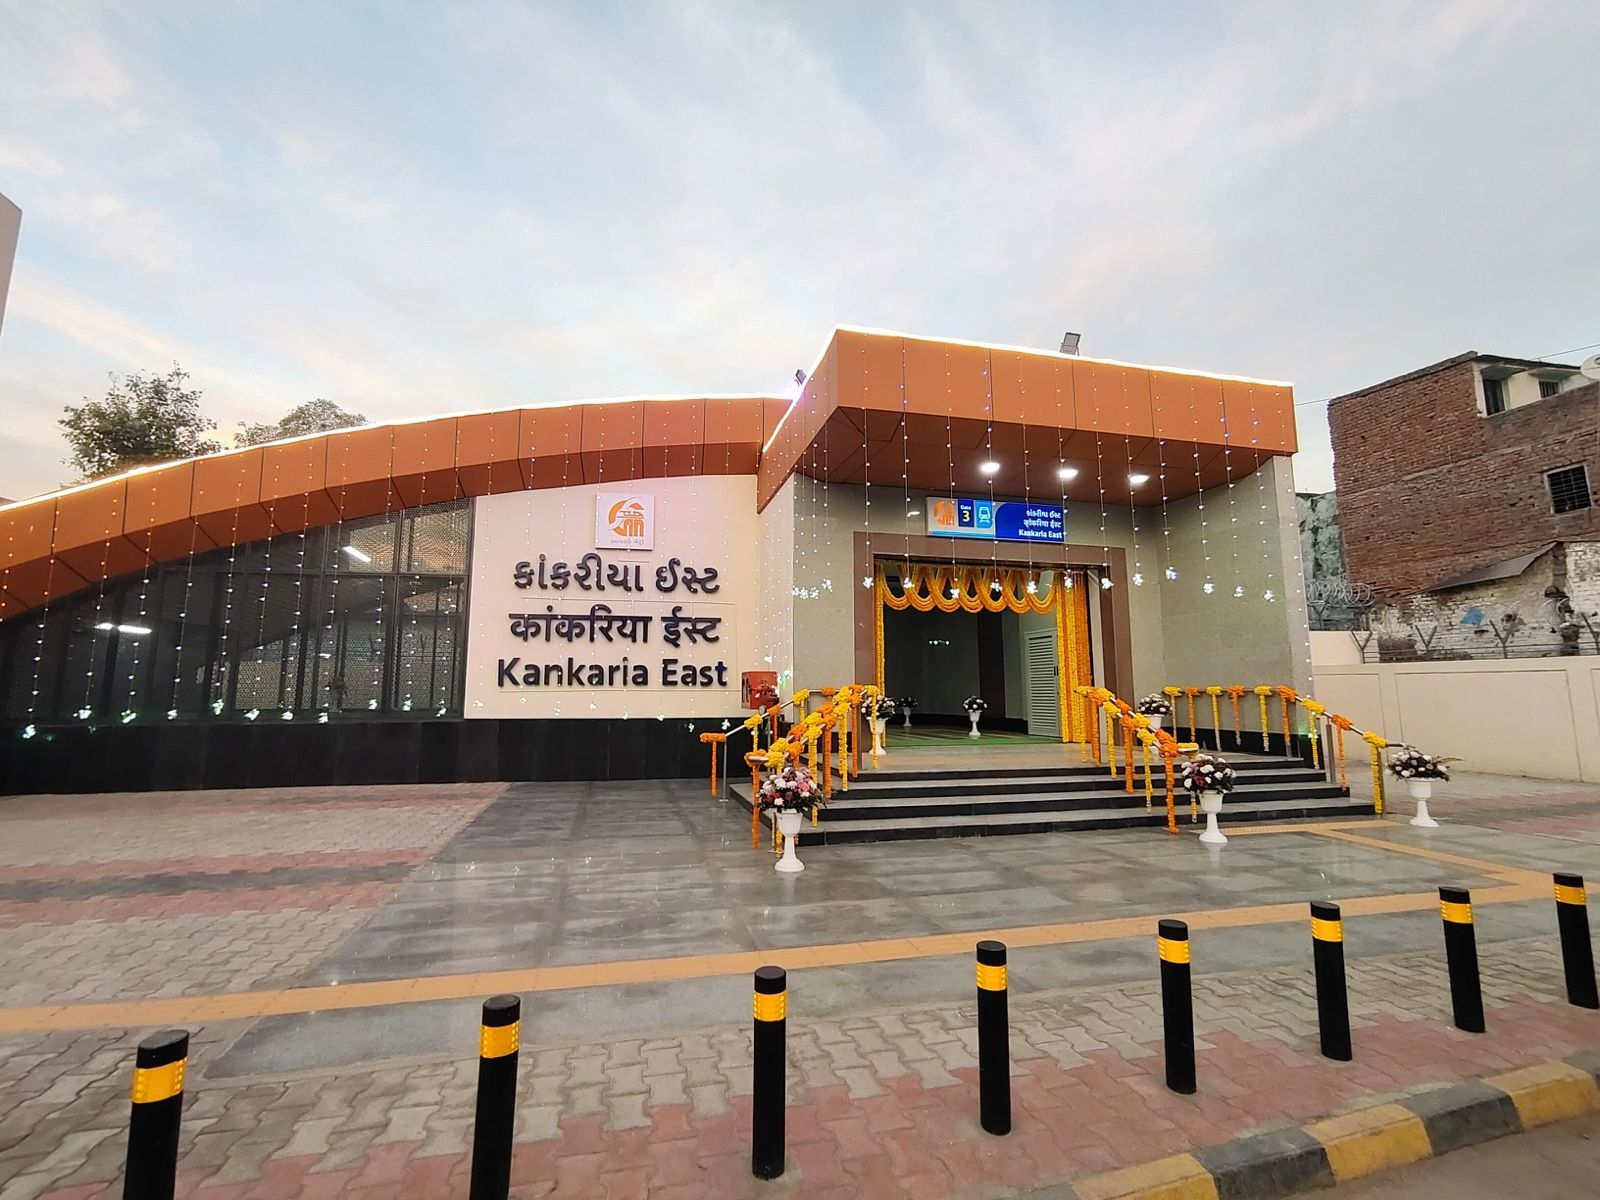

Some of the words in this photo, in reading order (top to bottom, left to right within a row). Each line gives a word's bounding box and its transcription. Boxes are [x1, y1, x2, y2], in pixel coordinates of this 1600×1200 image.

[962, 510, 970, 522] 3
[1018, 528, 1047, 538] Kankaria
[1048, 530, 1062, 539] East
[513, 552, 644, 592] કાંકરીયા
[655, 557, 720, 593] ઈસ્ટ
[509, 604, 652, 642] कांकरिया
[661, 606, 722, 648] ईस्ट
[498, 657, 649, 688] Kankaria
[662, 659, 728, 687] East
